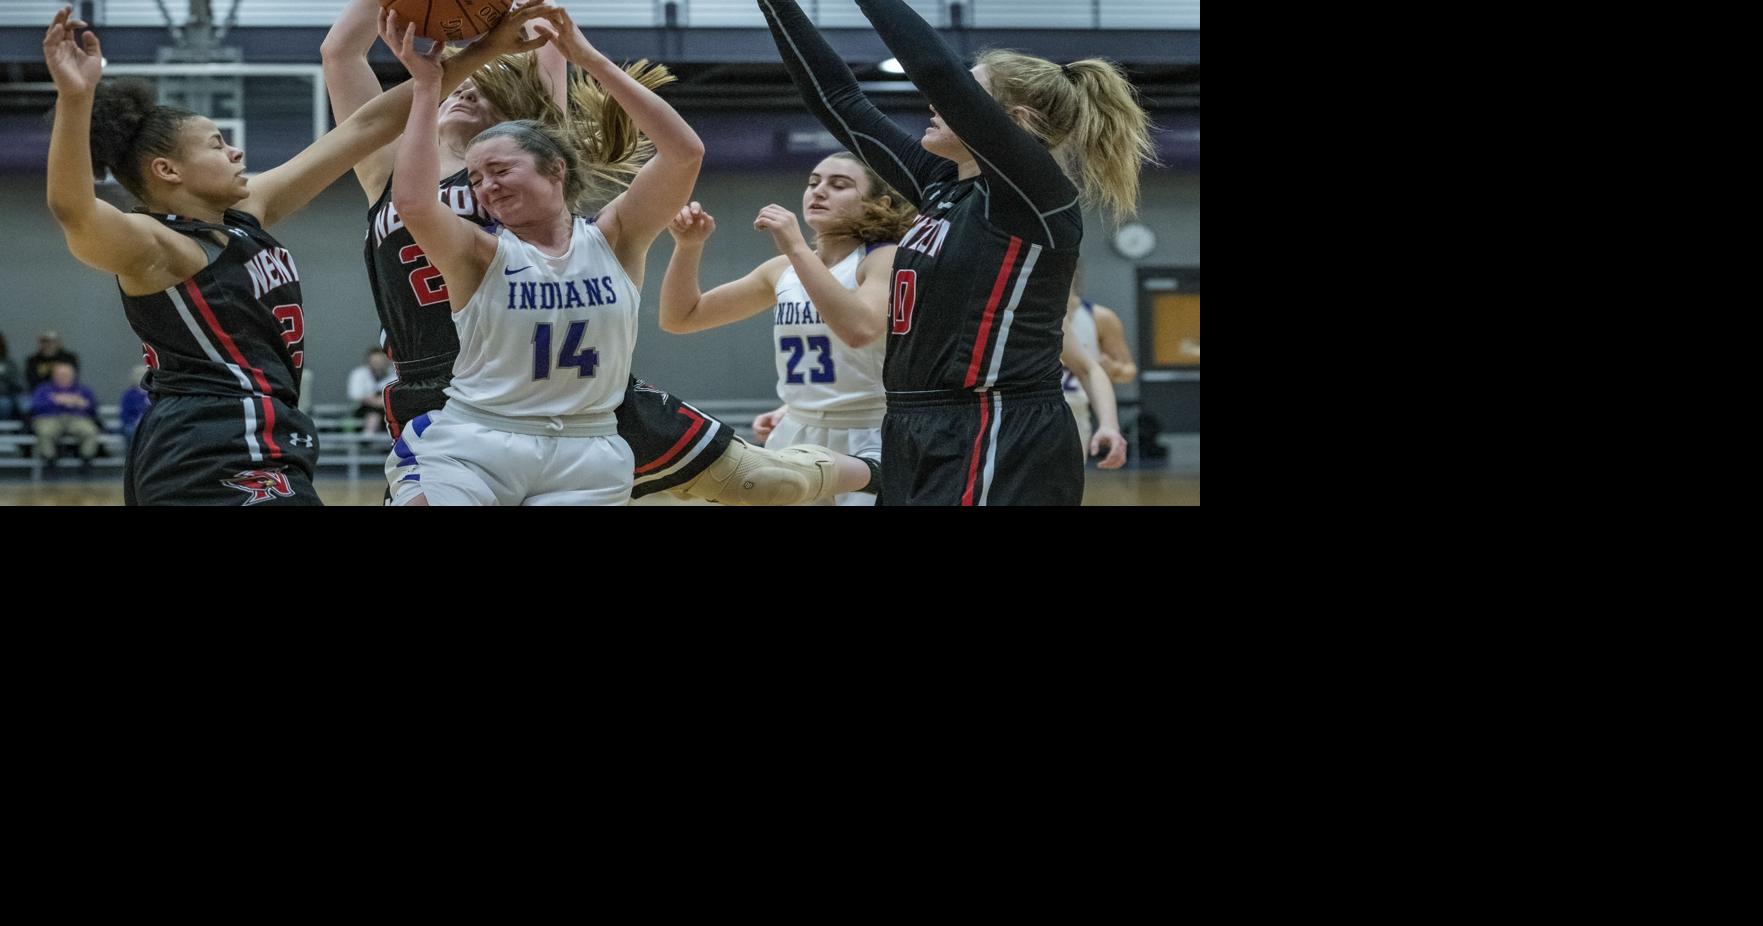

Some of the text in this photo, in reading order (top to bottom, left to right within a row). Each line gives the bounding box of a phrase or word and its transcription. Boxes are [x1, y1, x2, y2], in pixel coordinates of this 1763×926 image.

[507, 275, 617, 310] INDIANS
[530, 319, 600, 382] 14
[779, 334, 837, 385] 23
